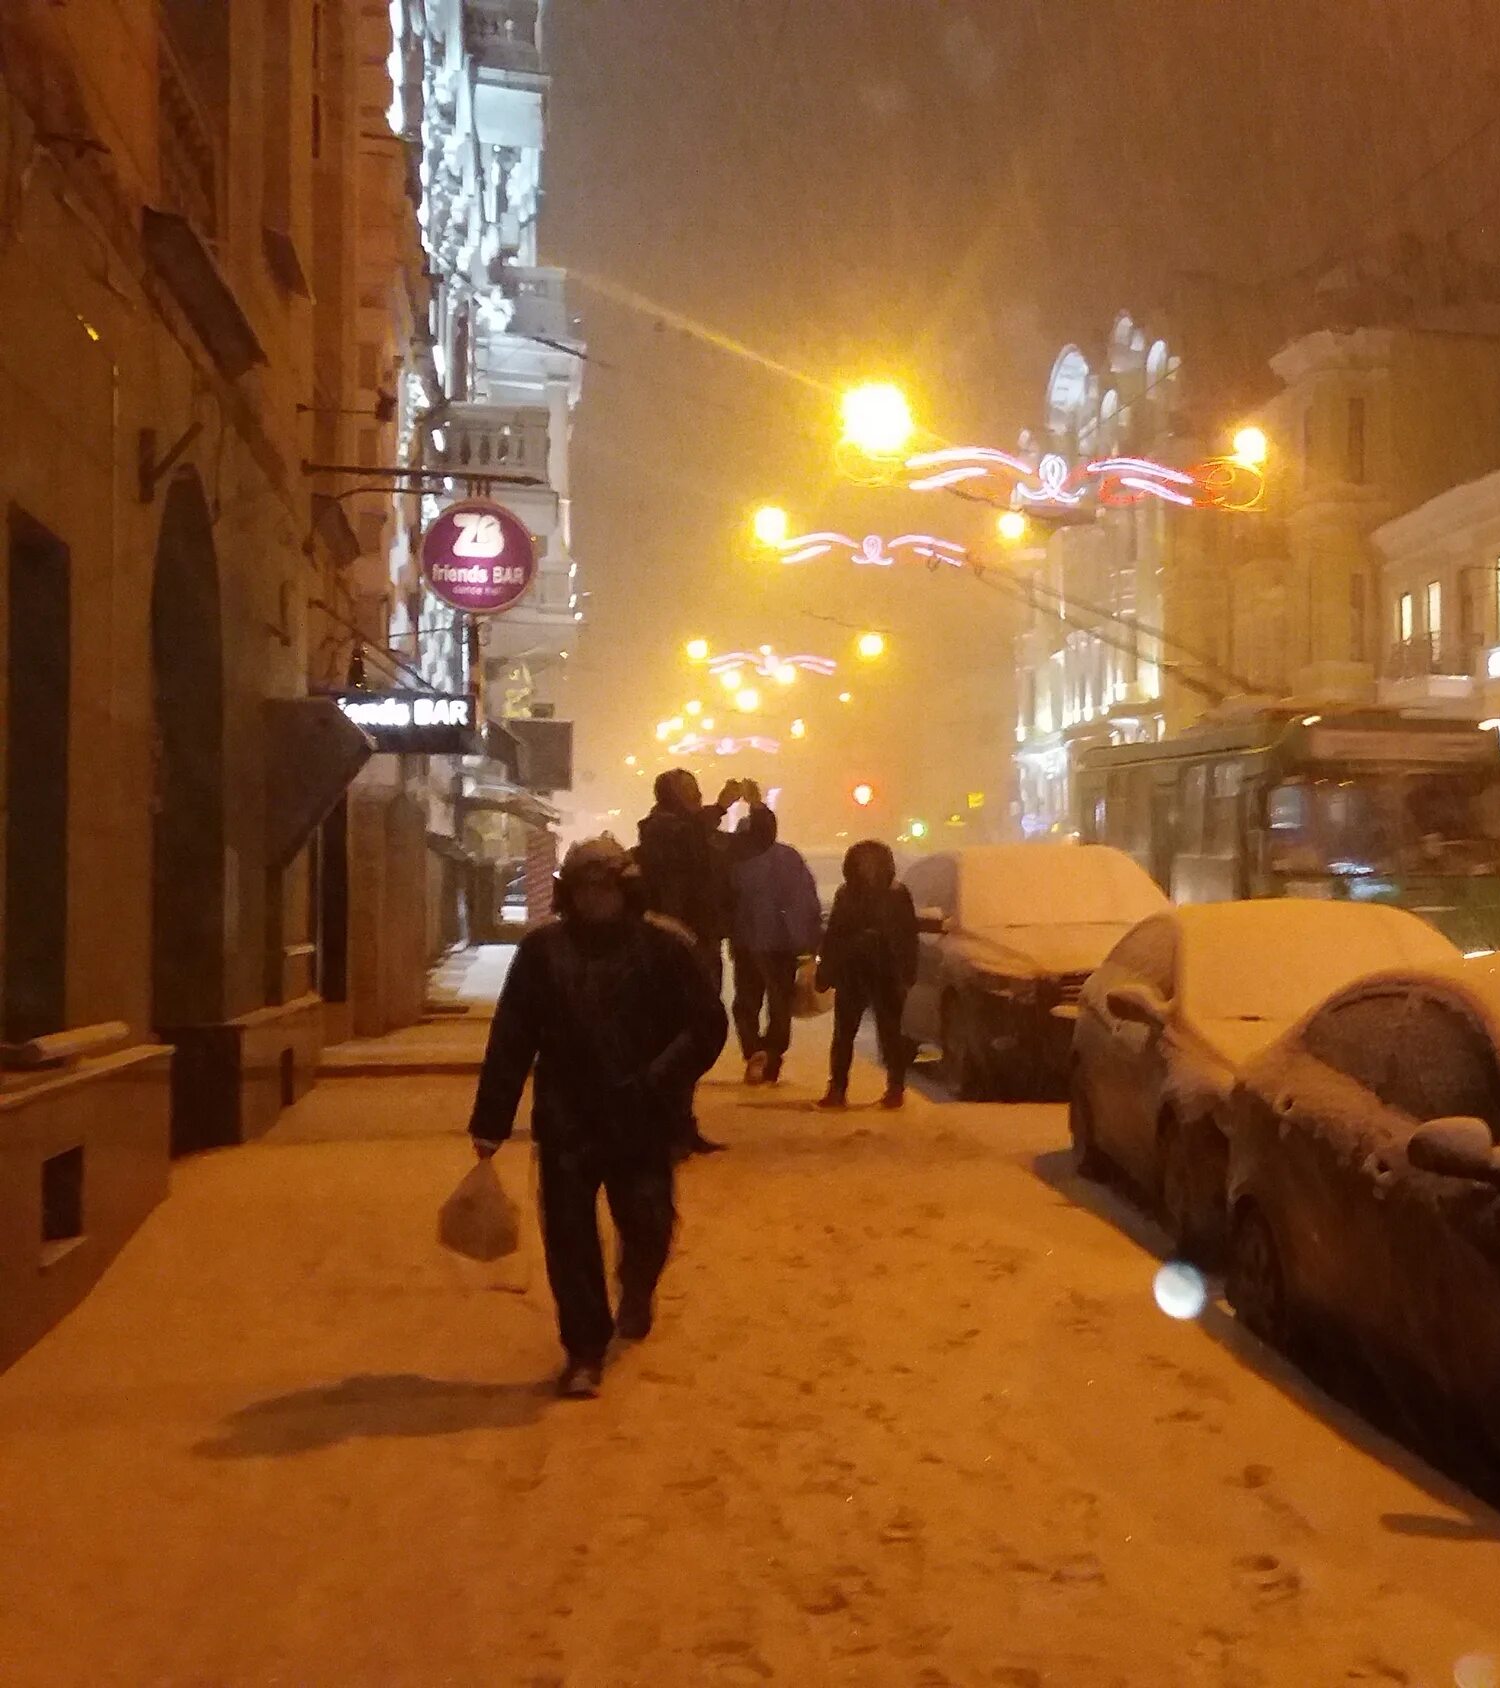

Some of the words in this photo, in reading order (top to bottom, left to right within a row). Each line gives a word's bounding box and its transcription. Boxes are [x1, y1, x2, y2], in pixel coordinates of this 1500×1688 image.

[432, 564, 488, 583] friends
[492, 565, 524, 584] BAR
[414, 698, 468, 725] BAR
